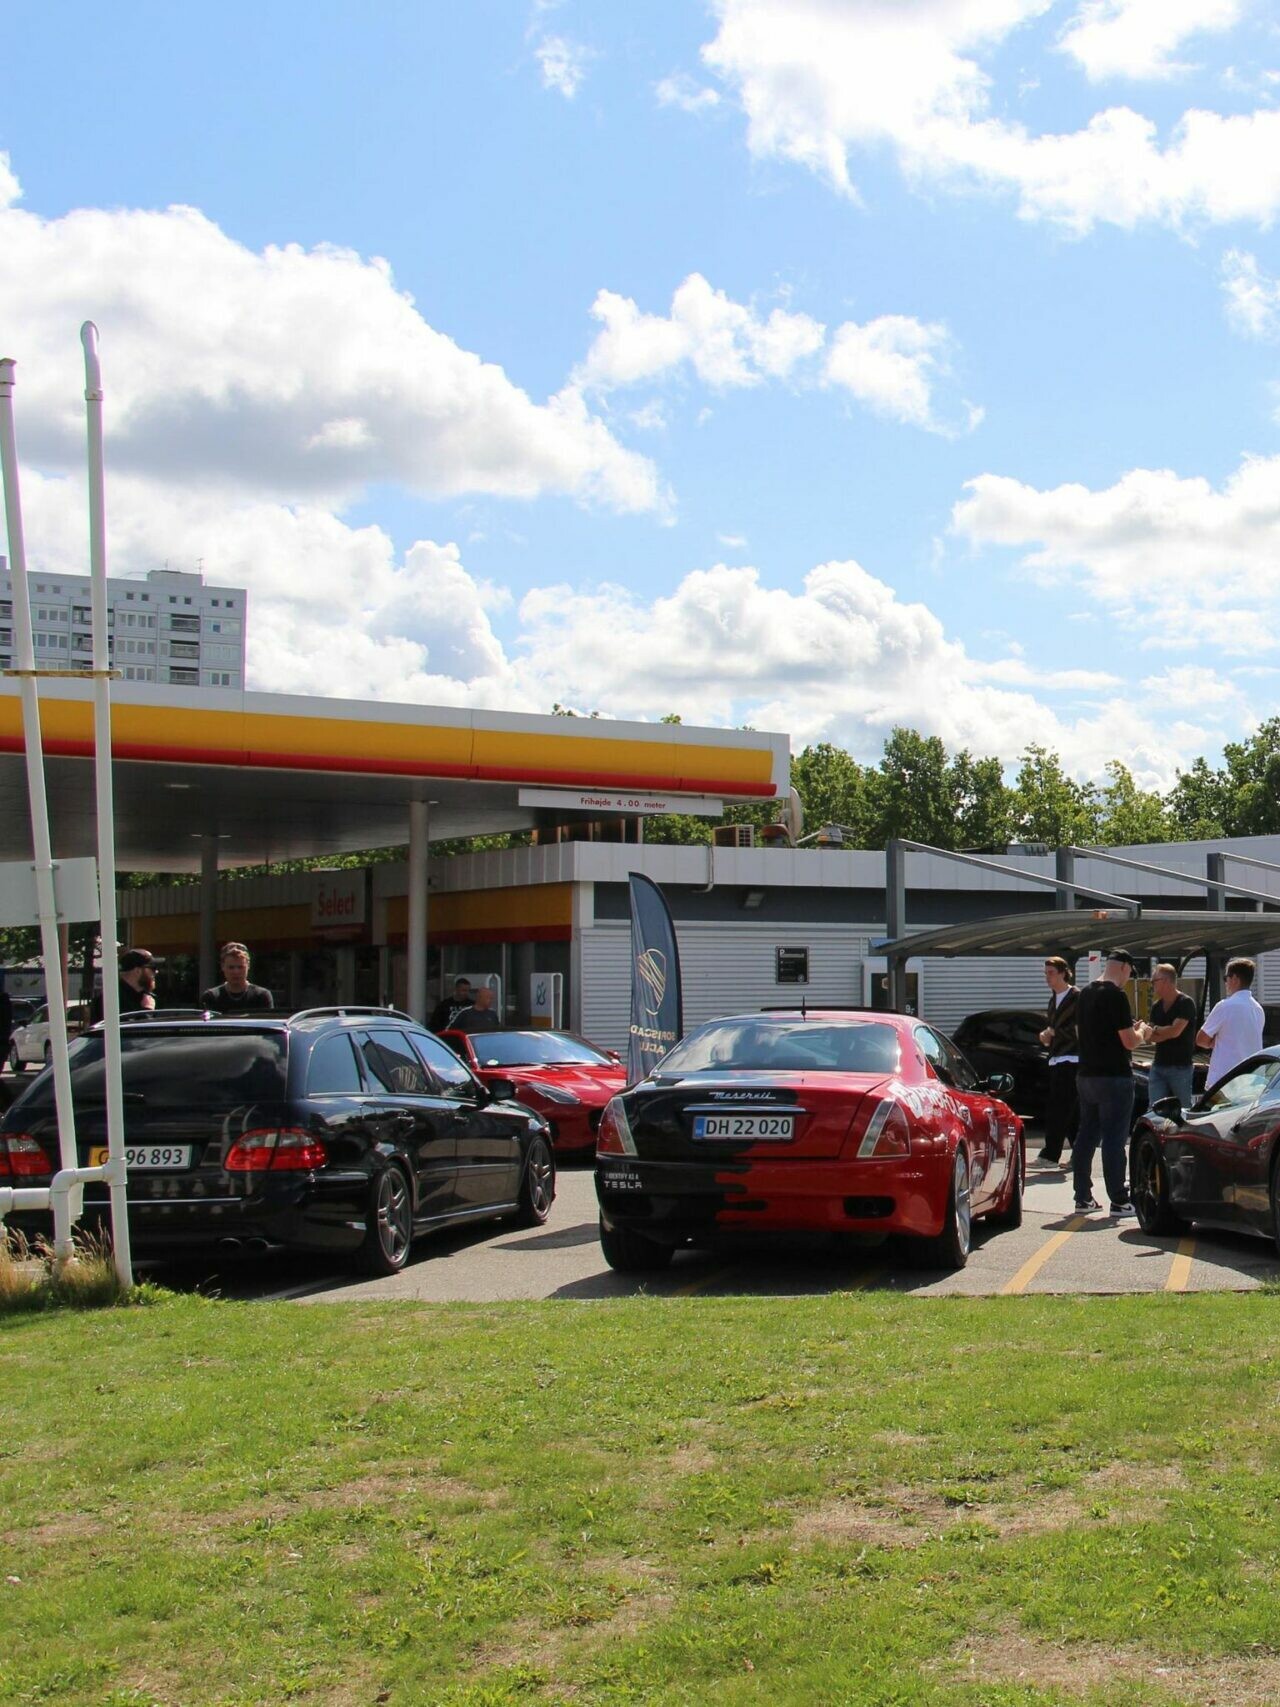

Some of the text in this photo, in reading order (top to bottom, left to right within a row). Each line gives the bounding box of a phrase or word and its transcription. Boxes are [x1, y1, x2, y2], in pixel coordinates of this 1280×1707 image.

[580, 797, 666, 809] Frihøjde 4.00 meter
[318, 887, 355, 916] Select
[706, 1119, 791, 1135] DH 22 020
[126, 1149, 146, 1165] 96
[150, 1148, 182, 1165] 893
[604, 1180, 642, 1189] TESLA
